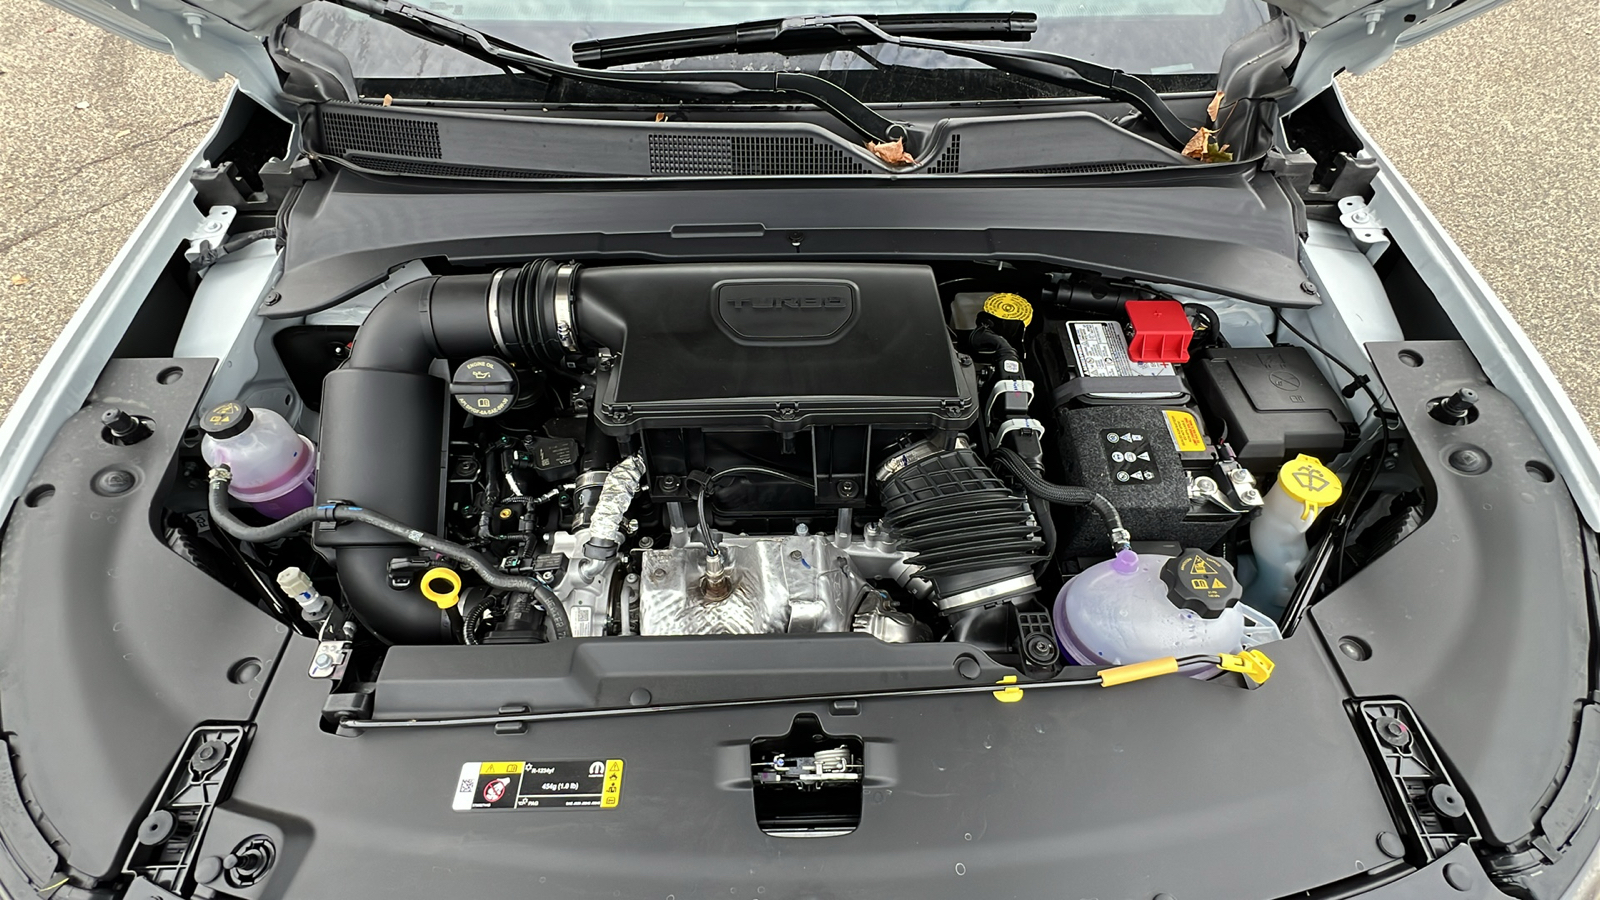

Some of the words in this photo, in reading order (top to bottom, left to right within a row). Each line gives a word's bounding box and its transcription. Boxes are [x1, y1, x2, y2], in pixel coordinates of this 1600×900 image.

[726, 297, 847, 310] TURBO
[466, 361, 485, 370] ENGINE
[486, 362, 494, 370] OIL
[541, 783, 557, 791] 454g
